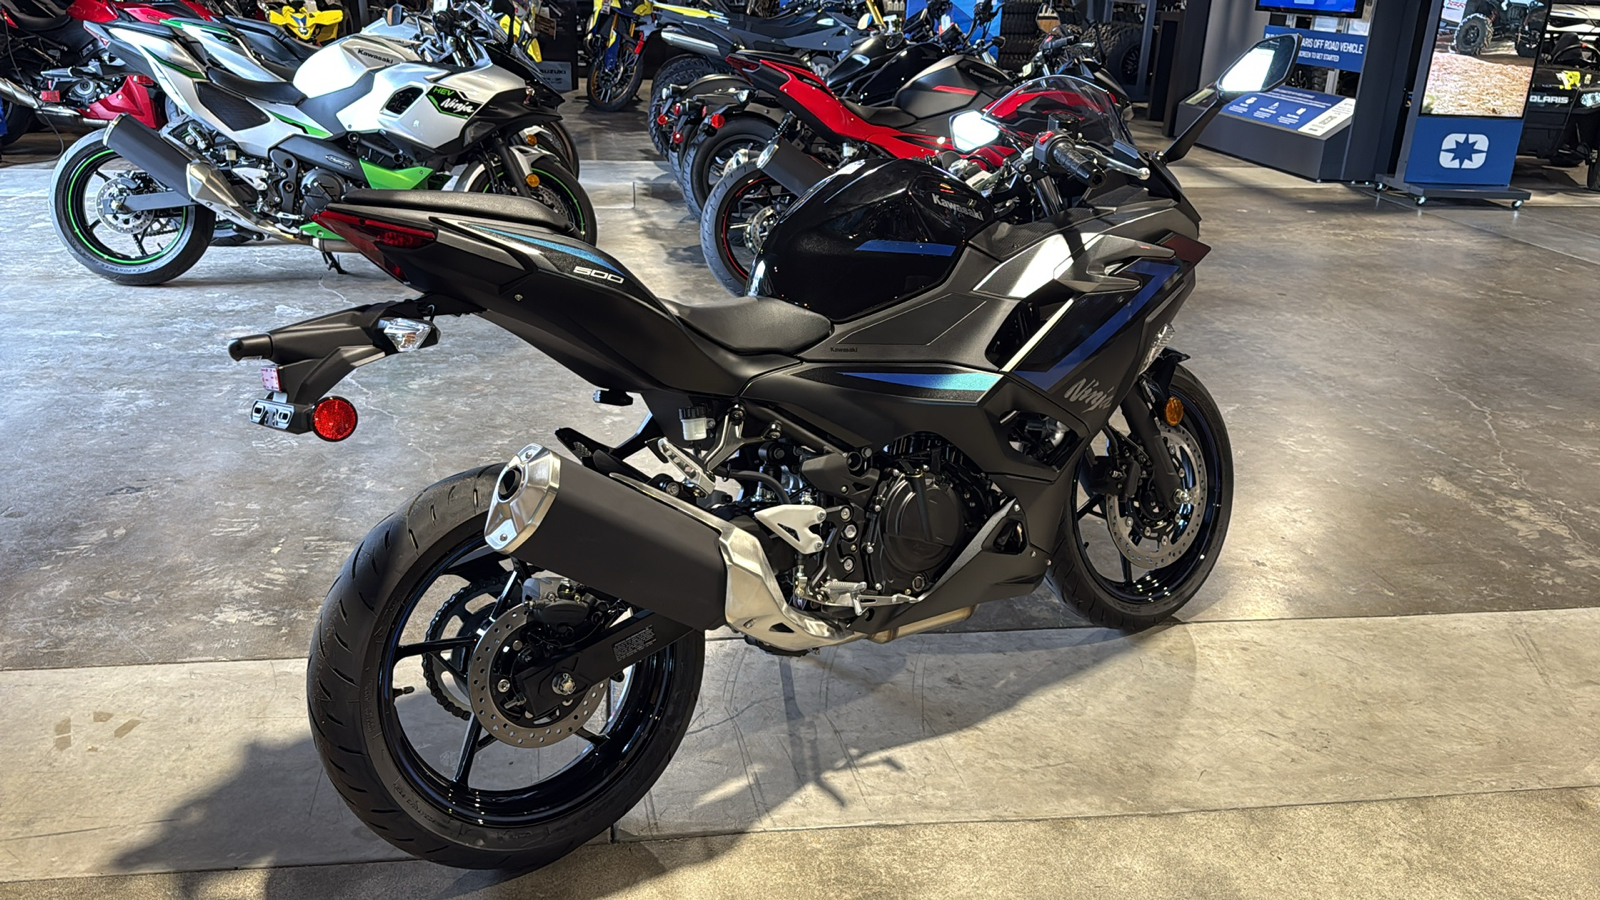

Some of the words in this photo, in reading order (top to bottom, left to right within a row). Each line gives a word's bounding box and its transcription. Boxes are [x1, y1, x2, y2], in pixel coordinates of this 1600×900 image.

[1313, 38, 1325, 49] OFF
[1324, 40, 1340, 51] ROAD
[1340, 42, 1365, 54] VEHICLE
[357, 48, 394, 64] Kawasaki
[432, 86, 455, 96] HEV
[440, 97, 475, 113] Ninja
[1529, 95, 1569, 104] OLARIS
[931, 193, 984, 221] Kawasaki
[573, 265, 624, 284] 500
[1064, 378, 1114, 413] Ninja
